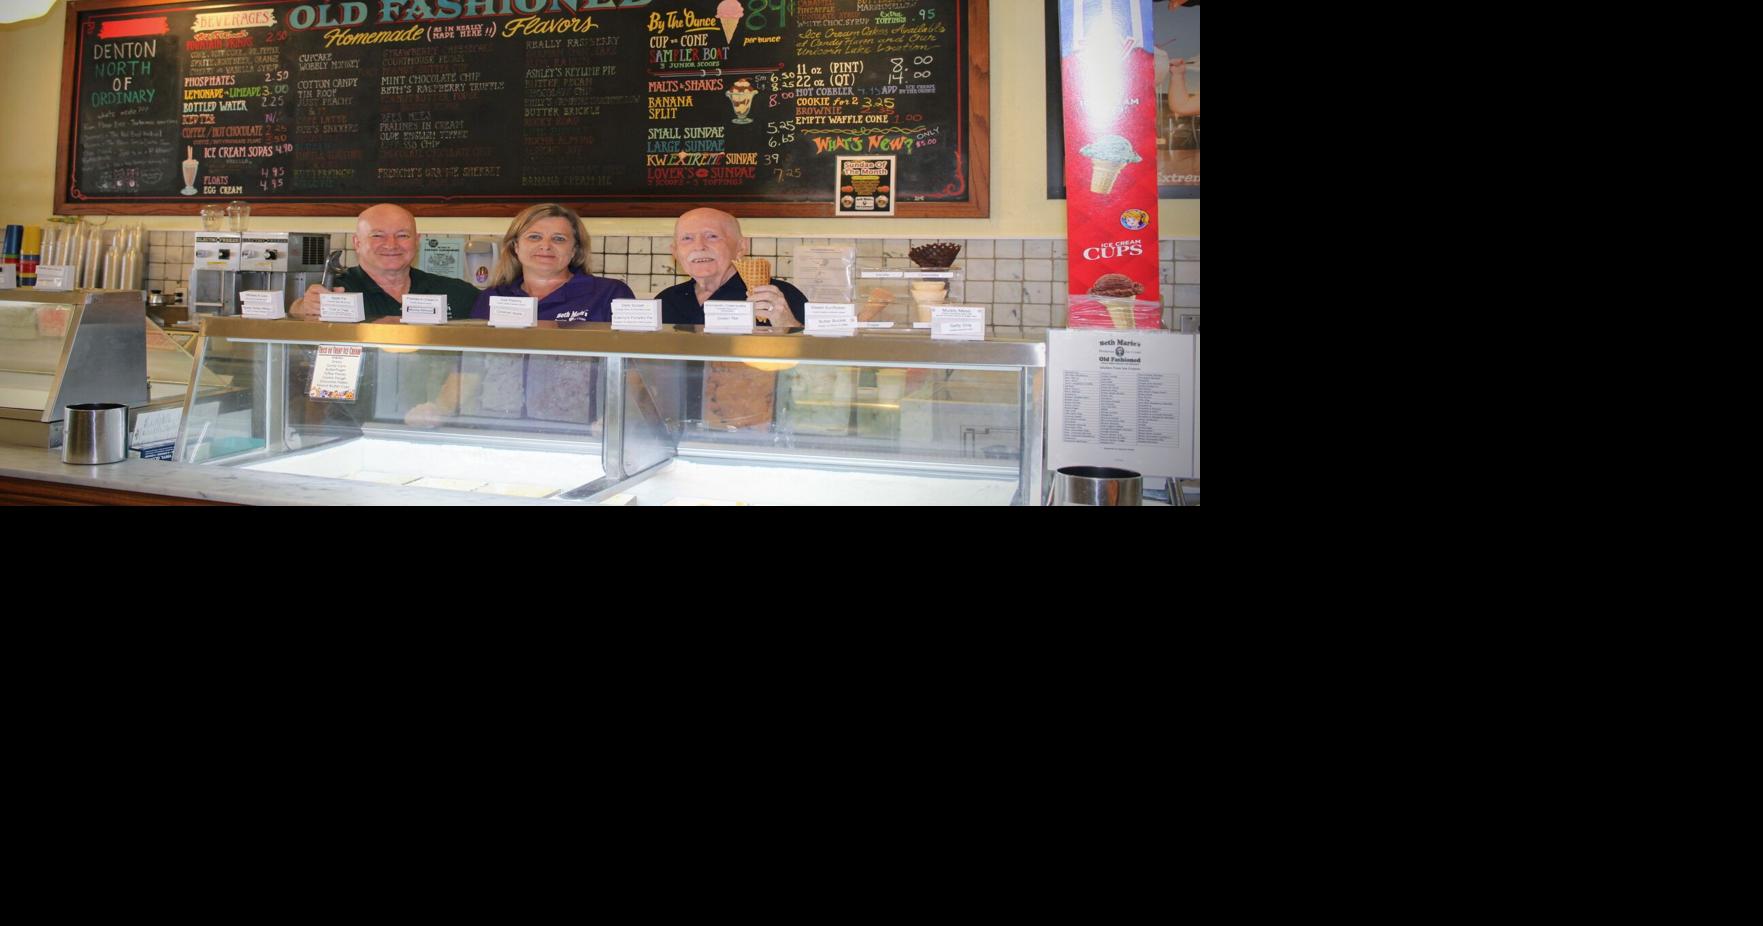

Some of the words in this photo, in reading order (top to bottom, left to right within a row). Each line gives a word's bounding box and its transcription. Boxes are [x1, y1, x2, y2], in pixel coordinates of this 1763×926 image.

[199, 12, 270, 28] BEVERAGES
[286, 3, 369, 31] OLD
[647, 11, 665, 33] By
[666, 11, 684, 29] The
[683, 8, 717, 27] Ounce
[502, 15, 599, 38] Flavors
[323, 24, 425, 48] Homemade
[649, 35, 669, 48] CUP
[680, 33, 708, 47] CONE
[743, 36, 757, 47] per
[757, 35, 782, 43] ounce
[93, 39, 156, 60] DENTON
[649, 48, 700, 63] SAMPLER
[703, 46, 730, 60] BOAT
[298, 52, 333, 63] CUPCAKE
[94, 60, 152, 78] NORTH
[525, 66, 563, 78] ASHLEY'S
[601, 65, 617, 76] PIE
[796, 63, 807, 75] 11
[811, 66, 823, 75] oz
[829, 60, 864, 75] (PINT)
[184, 75, 236, 87] PHOSPHATES
[265, 71, 289, 82] 2.50
[297, 79, 331, 90] COTTON
[332, 77, 359, 88] CANDY
[381, 75, 406, 86] MINT
[408, 73, 457, 84] CHOCOLATE
[459, 71, 481, 81] CHIP
[796, 76, 811, 87] 22
[813, 79, 825, 87] oz
[829, 73, 855, 87] (QT)
[112, 76, 133, 92] OF
[380, 85, 413, 95] BETH'S
[648, 80, 679, 92] MALTS
[684, 78, 724, 91] SHAKES
[796, 86, 814, 97] HOT
[815, 85, 855, 96] COBBLER
[91, 88, 156, 108] ORDINARY
[183, 88, 225, 100] LEMONADE
[229, 86, 261, 98] LIMEADE
[182, 102, 217, 113] BOTTLED
[219, 100, 248, 112] WATER
[648, 95, 694, 107] BANANA
[796, 97, 830, 106] COOKIE
[833, 97, 850, 106] for
[850, 96, 859, 106] 2
[648, 108, 678, 120] SPLIT
[796, 106, 842, 115] BROWNIE
[795, 115, 828, 125] EMPTY
[828, 115, 863, 124] WAFFLE
[865, 114, 889, 123] CONE
[182, 127, 207, 138] COFFEE
[212, 127, 226, 138] HOT
[226, 125, 263, 137] CHOCOLATE
[648, 127, 682, 140] SMALL
[683, 126, 725, 139] SUNDAE
[916, 126, 940, 140] ONLY
[203, 147, 216, 159] ICE
[218, 146, 246, 159] CREAM
[247, 145, 273, 158] SODAS
[647, 140, 681, 153] LARGE
[684, 139, 725, 152] SUNDAE
[647, 153, 668, 166] KW
[667, 152, 725, 166] EXTREME
[726, 152, 758, 165] SUNDAE
[844, 161, 875, 169] Sundae
[875, 160, 888, 169] Of
[647, 167, 695, 179] LOVER'S
[710, 166, 756, 179] SUNDAE
[843, 168, 860, 176] The
[861, 168, 888, 176] Month
[203, 175, 230, 185] FLOATS
[203, 186, 217, 194] EGG
[219, 185, 244, 194] CREAM
[1083, 244, 1143, 261] CUPS
